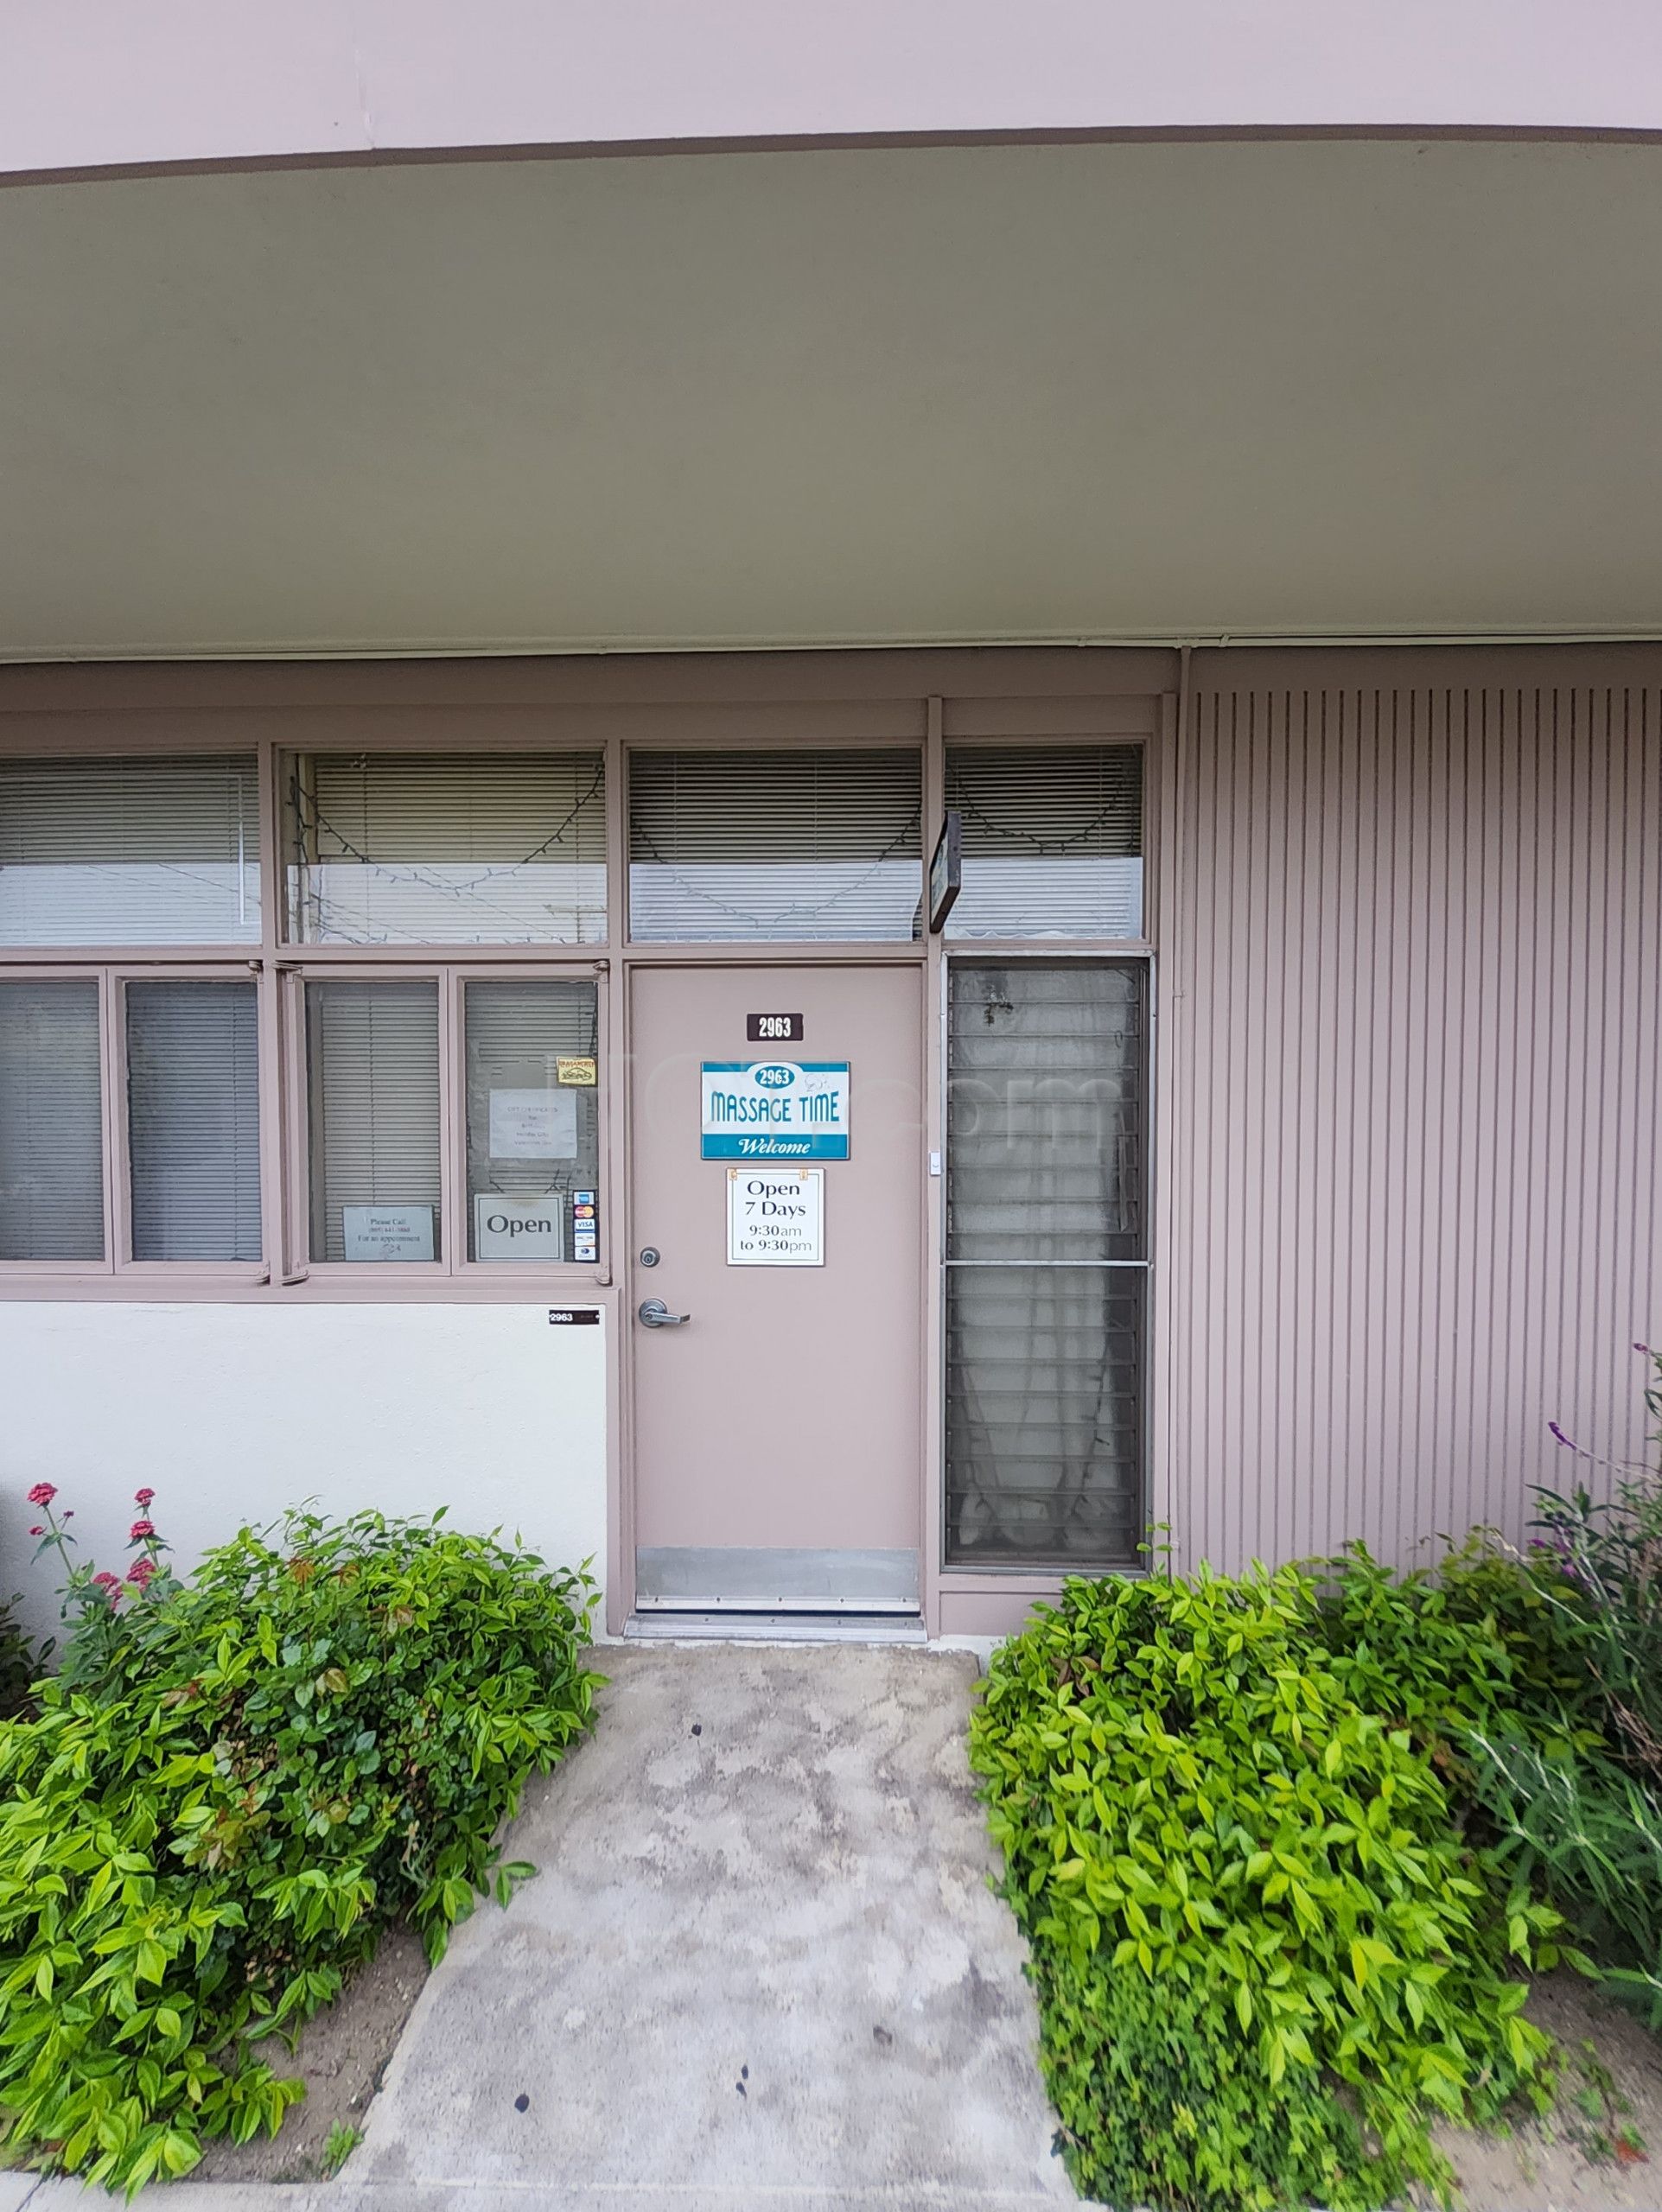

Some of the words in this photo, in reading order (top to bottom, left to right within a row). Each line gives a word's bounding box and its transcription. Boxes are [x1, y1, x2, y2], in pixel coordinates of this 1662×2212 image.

[758, 1016, 792, 1038] 2963
[758, 1068, 791, 1086] 2963
[710, 1090, 793, 1122] MASSAGE
[799, 1090, 841, 1122] TIME
[737, 1137, 812, 1154] Welcome
[746, 1179, 801, 1199] Open
[745, 1201, 756, 1217] 7
[761, 1201, 806, 1220] Days
[486, 1214, 552, 1238] Open
[748, 1224, 803, 1237] 9:30am
[740, 1239, 755, 1252] to
[758, 1239, 813, 1254] 9:30pm
[550, 1313, 574, 1322] 2963
